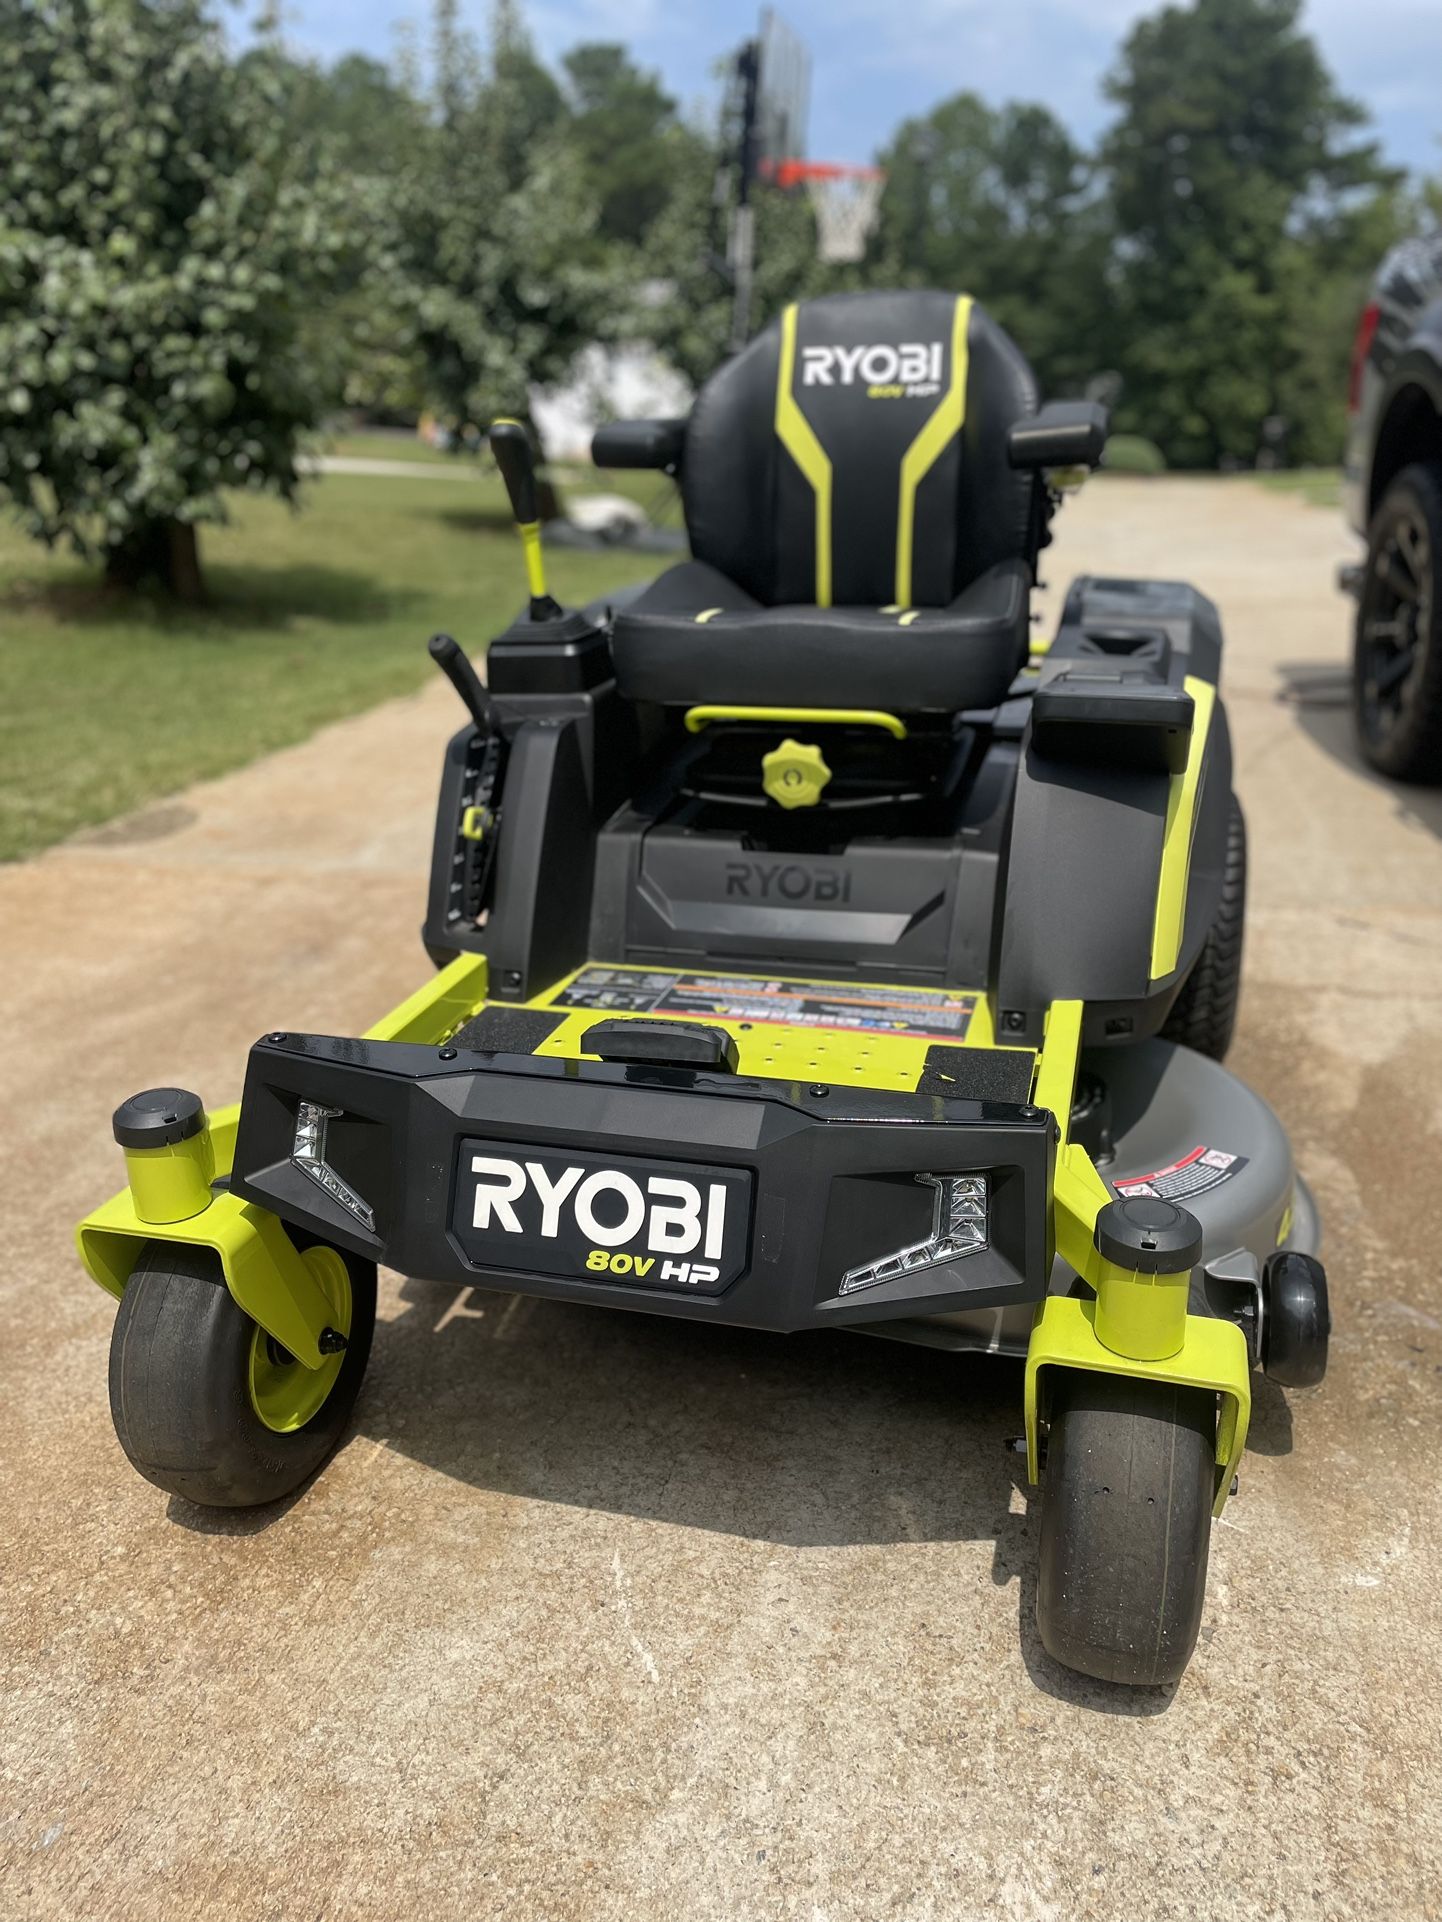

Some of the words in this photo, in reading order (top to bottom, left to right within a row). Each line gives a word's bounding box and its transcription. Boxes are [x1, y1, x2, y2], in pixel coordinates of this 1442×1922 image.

[803, 343, 943, 385] RYOBI
[726, 863, 852, 902] RYOBI
[472, 1156, 727, 1260] RYOBI
[585, 1250, 655, 1277] 80V
[660, 1260, 720, 1284] HP
